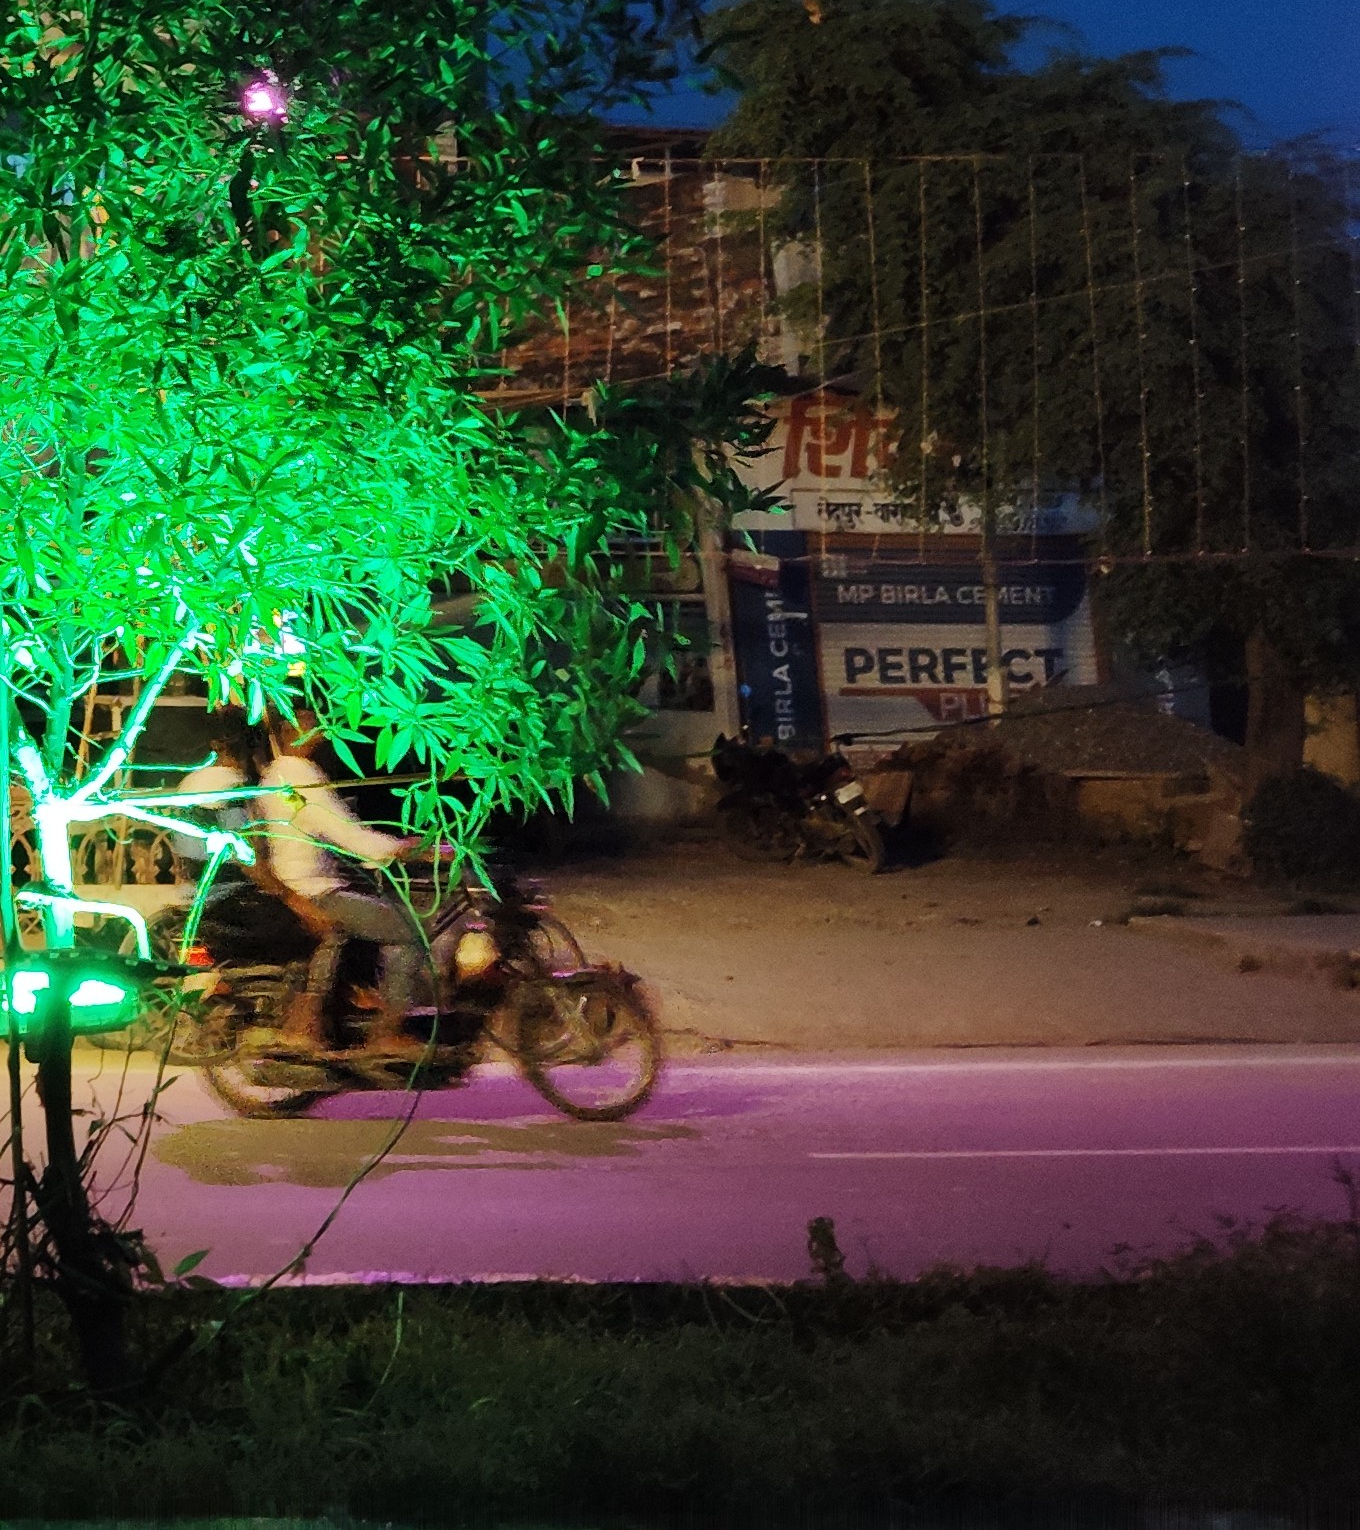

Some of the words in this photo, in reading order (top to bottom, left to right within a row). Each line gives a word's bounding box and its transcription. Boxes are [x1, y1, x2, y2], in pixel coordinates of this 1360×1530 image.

[836, 585, 875, 604] MP
[880, 585, 950, 605] BIRLA
[772, 663, 796, 741] BIRLA
